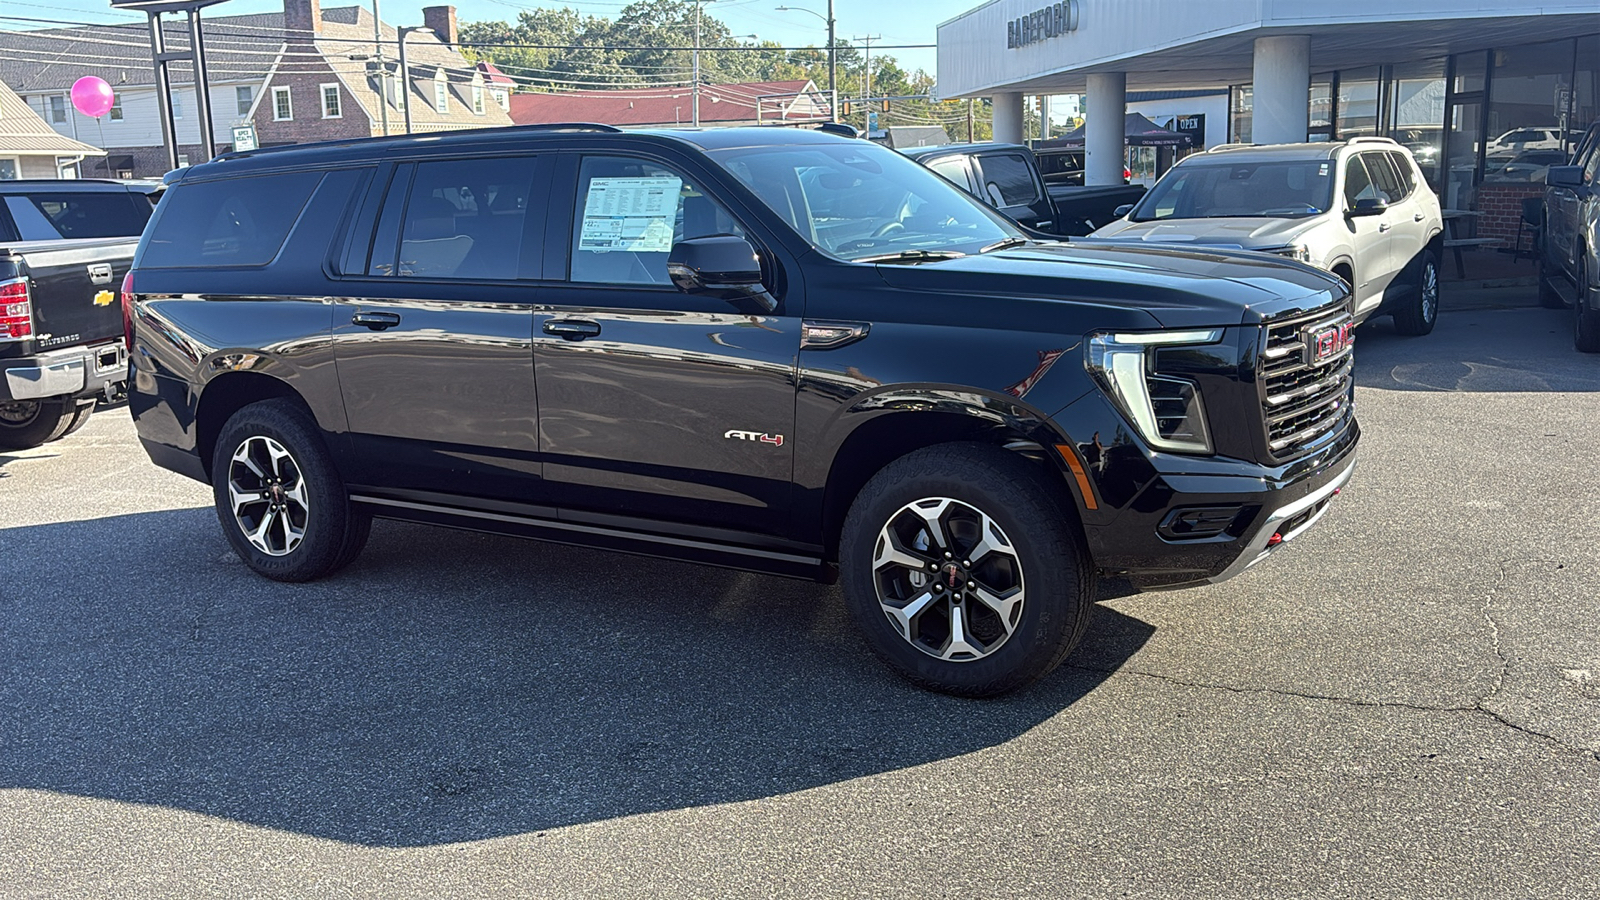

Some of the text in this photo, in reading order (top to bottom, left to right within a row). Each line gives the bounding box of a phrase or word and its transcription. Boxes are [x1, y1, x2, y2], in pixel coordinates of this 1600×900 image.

[1007, 0, 1078, 49] BAREFORD
[1180, 118, 1198, 129] OPEN
[40, 333, 80, 347] SILVERADO
[808, 329, 833, 337] GMC
[1318, 322, 1354, 358] GMC
[724, 429, 783, 447] AT4
